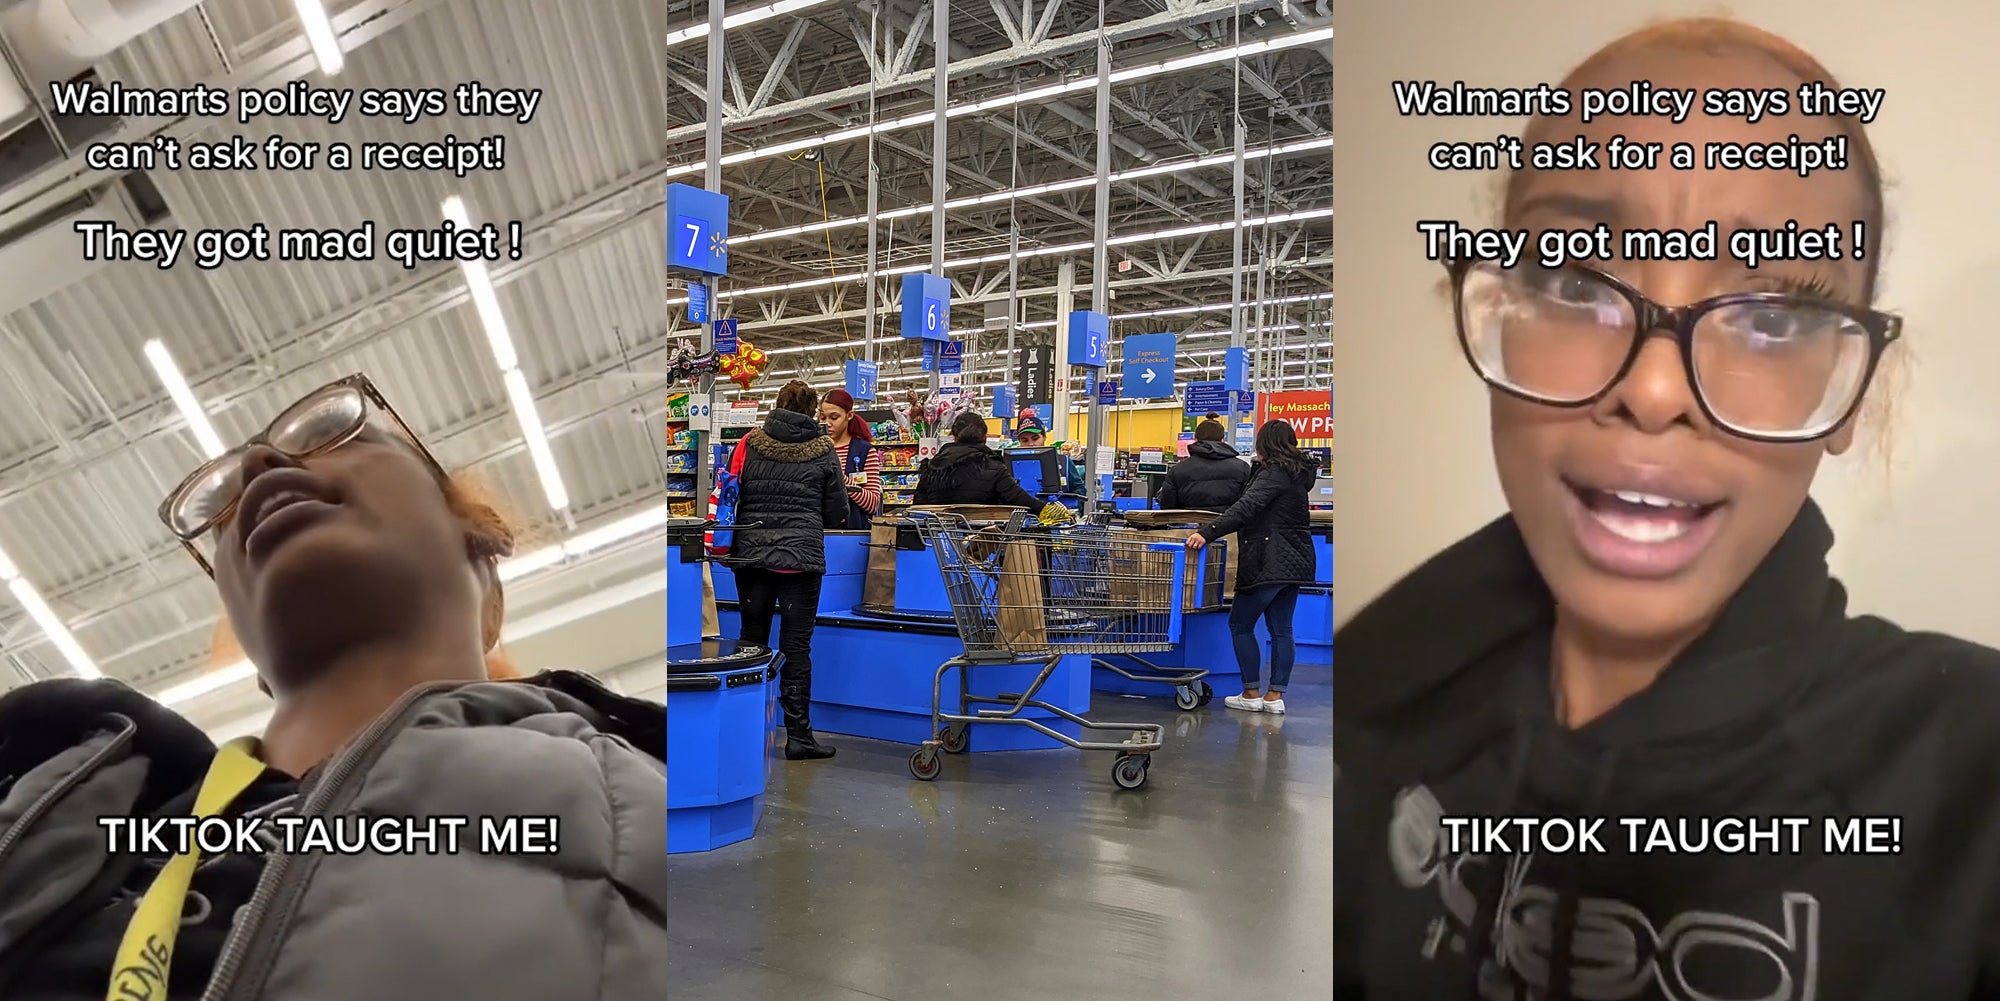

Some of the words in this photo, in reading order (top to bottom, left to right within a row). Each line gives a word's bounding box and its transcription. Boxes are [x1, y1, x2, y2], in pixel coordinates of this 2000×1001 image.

[686, 224, 700, 257] 7
[927, 303, 936, 331] 6
[1090, 336, 1097, 358] 5
[1141, 356, 1169, 364] Checkout
[860, 378, 866, 394] 3
[1027, 367, 1038, 399] Ladies
[1264, 402, 1284, 414] Hey
